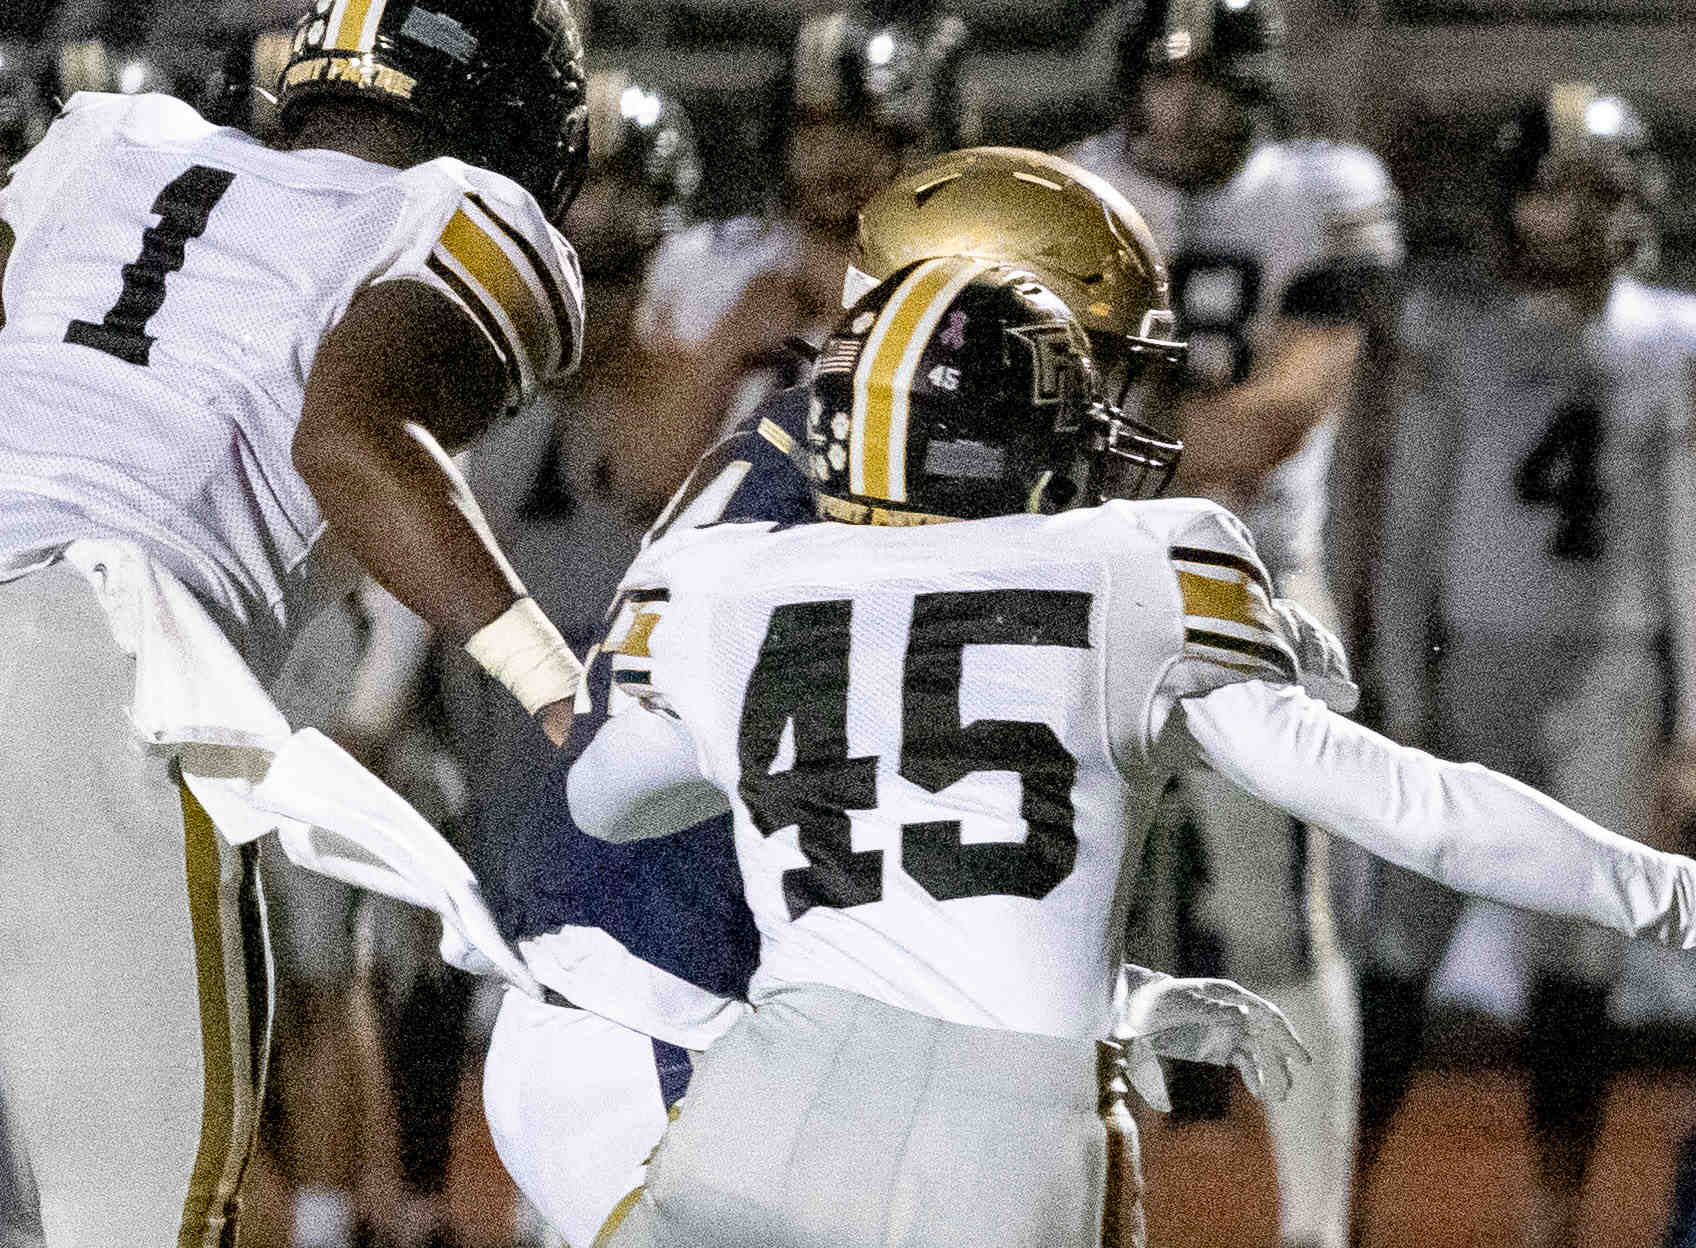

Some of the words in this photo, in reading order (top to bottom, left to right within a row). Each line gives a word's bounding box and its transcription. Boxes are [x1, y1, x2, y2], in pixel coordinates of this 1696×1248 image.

[62, 164, 237, 367] 1
[927, 364, 963, 391] 45
[1513, 399, 1606, 561] 4
[737, 588, 1093, 921] 45
